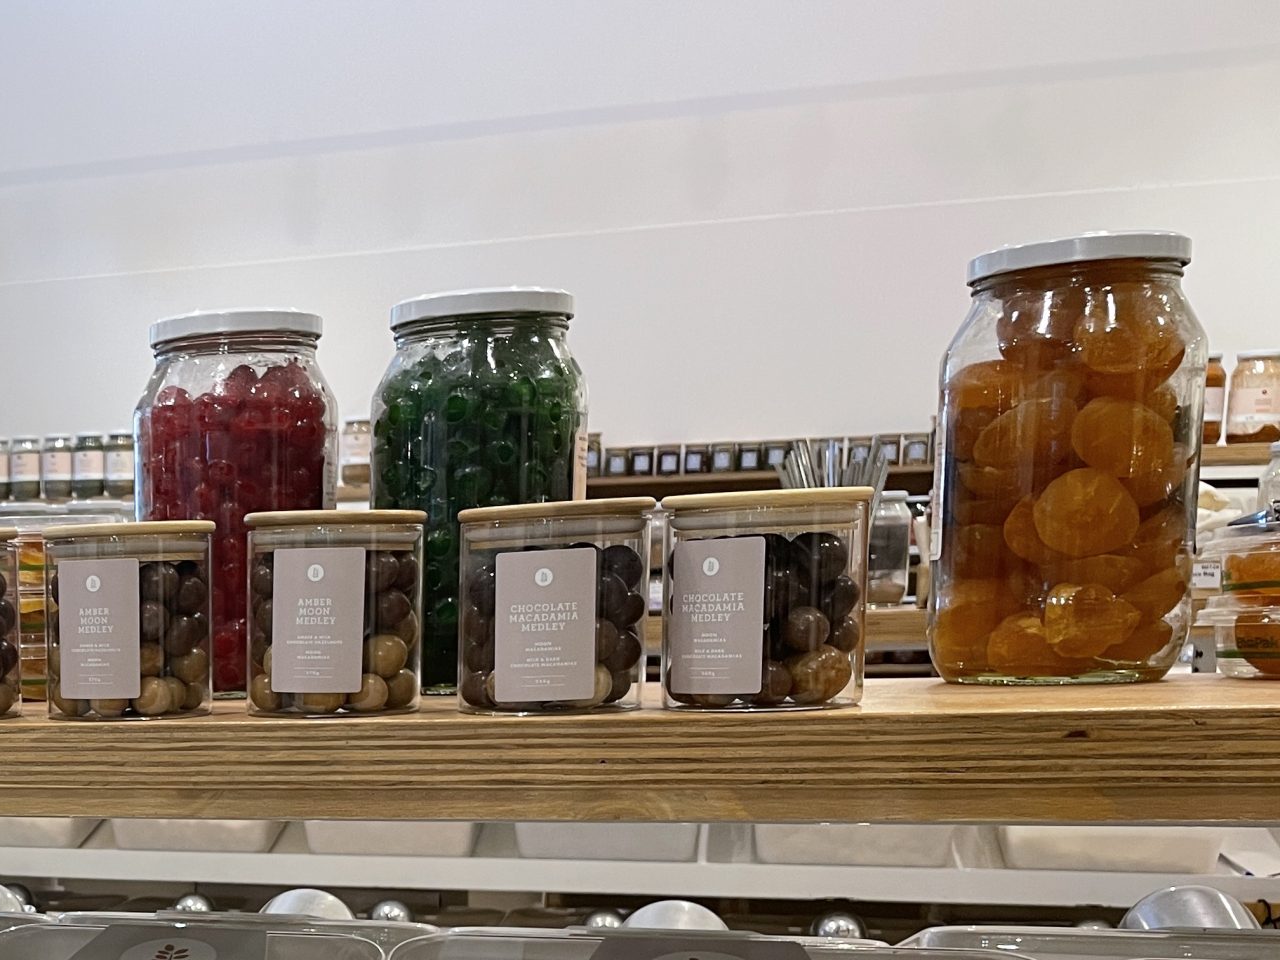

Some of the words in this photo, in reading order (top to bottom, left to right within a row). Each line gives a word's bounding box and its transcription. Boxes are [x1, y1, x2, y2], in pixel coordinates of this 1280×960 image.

[297, 598, 333, 606] AMBER
[683, 592, 745, 603] CHOCOLATE
[79, 608, 110, 616] AMBER
[299, 607, 331, 616] MOON
[510, 602, 578, 613] CHOCOLATE
[682, 602, 745, 613] MACADAMIA
[80, 616, 108, 625] MOON
[296, 616, 336, 625] MEDLEY
[509, 611, 578, 623] MACADAMIA
[691, 612, 731, 622] MEDLEY
[78, 625, 114, 633] MEDLEY
[521, 622, 566, 632] MEDLEY
